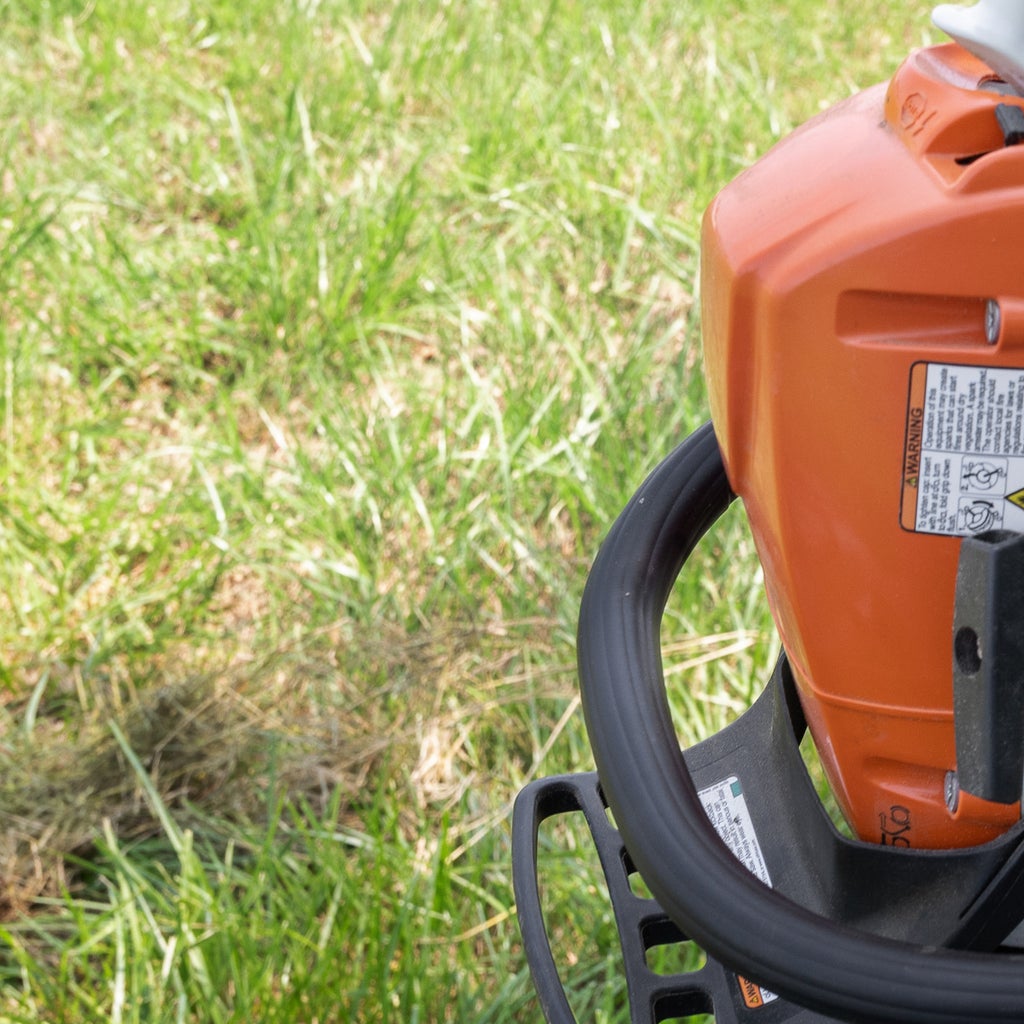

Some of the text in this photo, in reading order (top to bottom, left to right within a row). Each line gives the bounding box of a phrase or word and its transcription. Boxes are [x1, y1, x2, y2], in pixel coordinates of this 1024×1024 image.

[928, 402, 935, 410] of
[906, 407, 922, 474] WARNING
[924, 412, 934, 447] Operation
[936, 411, 944, 448] equipment
